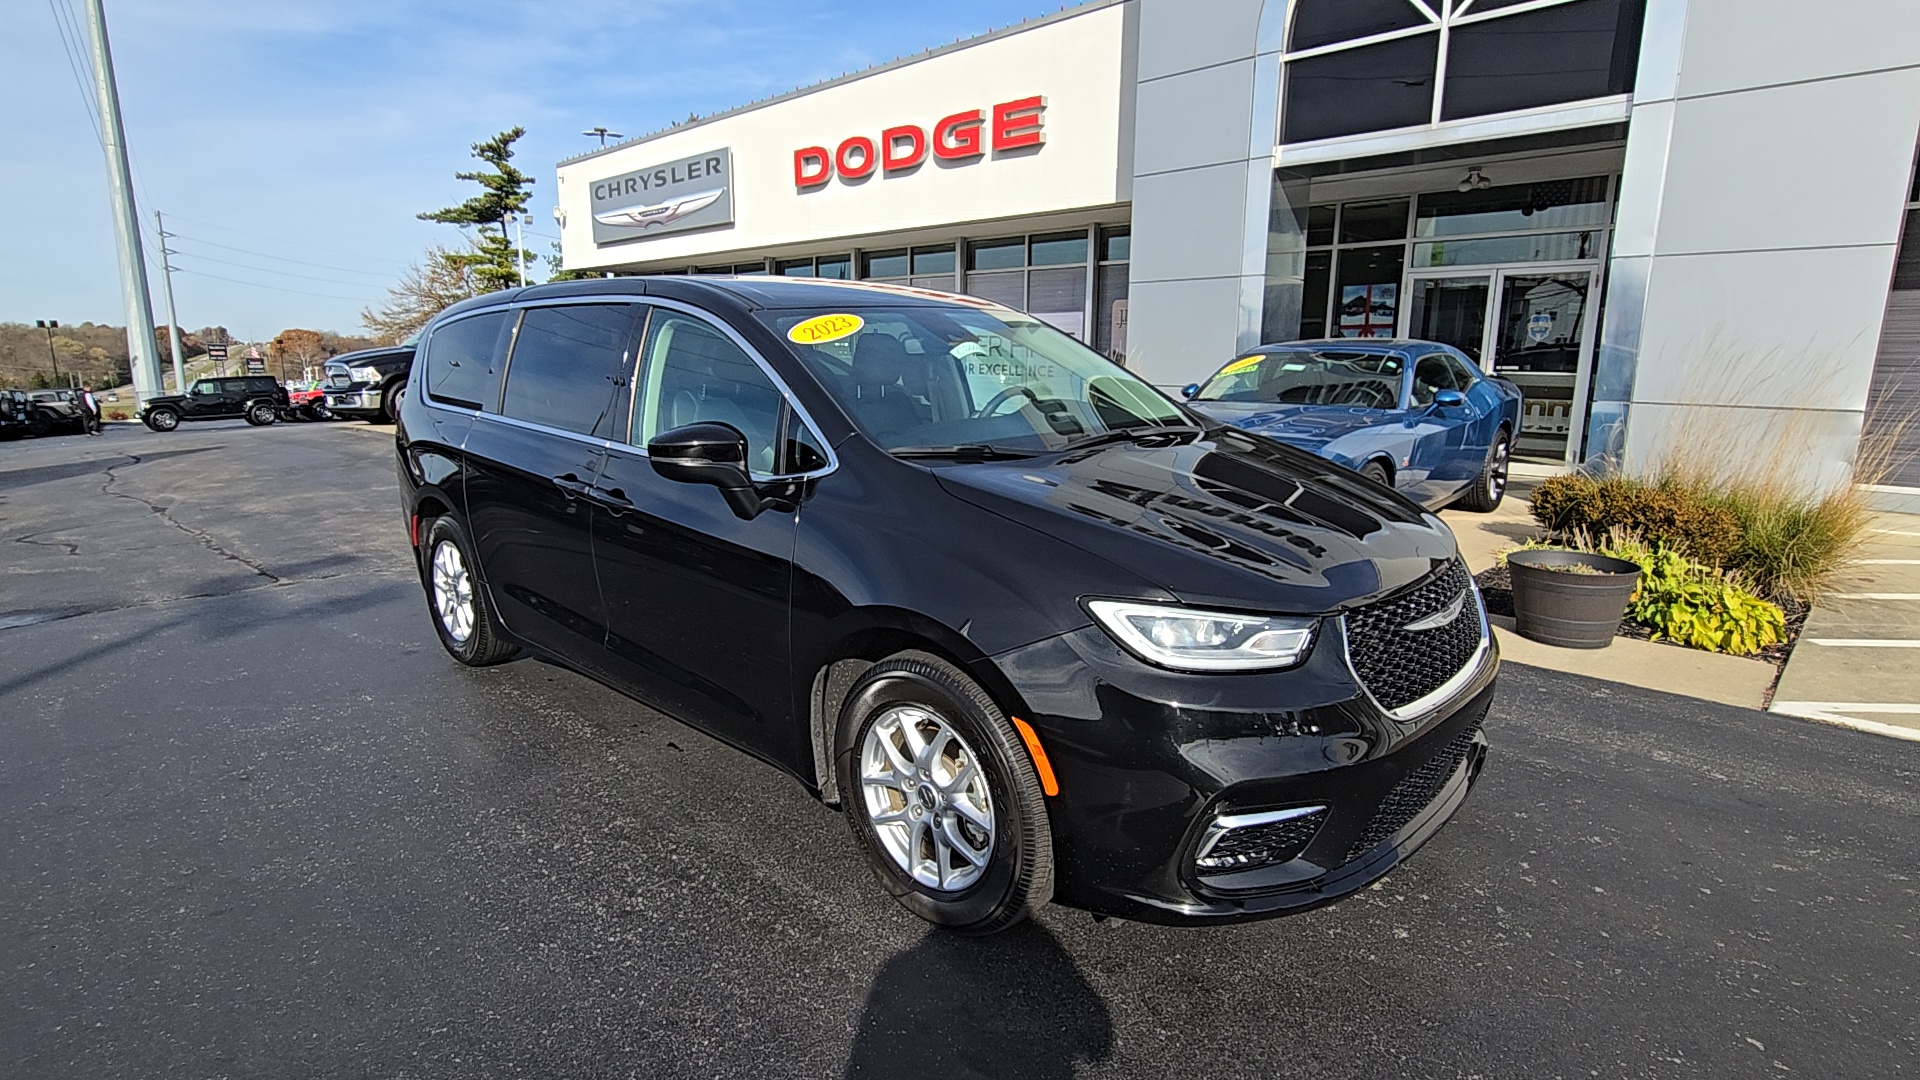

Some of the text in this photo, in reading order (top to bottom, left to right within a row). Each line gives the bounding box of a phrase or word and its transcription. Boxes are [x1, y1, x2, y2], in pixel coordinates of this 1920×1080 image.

[794, 95, 1046, 188] DODGE
[595, 157, 721, 200] CHRYSLER
[803, 316, 852, 340] 2023
[978, 363, 1054, 378] EXCELLNCE
